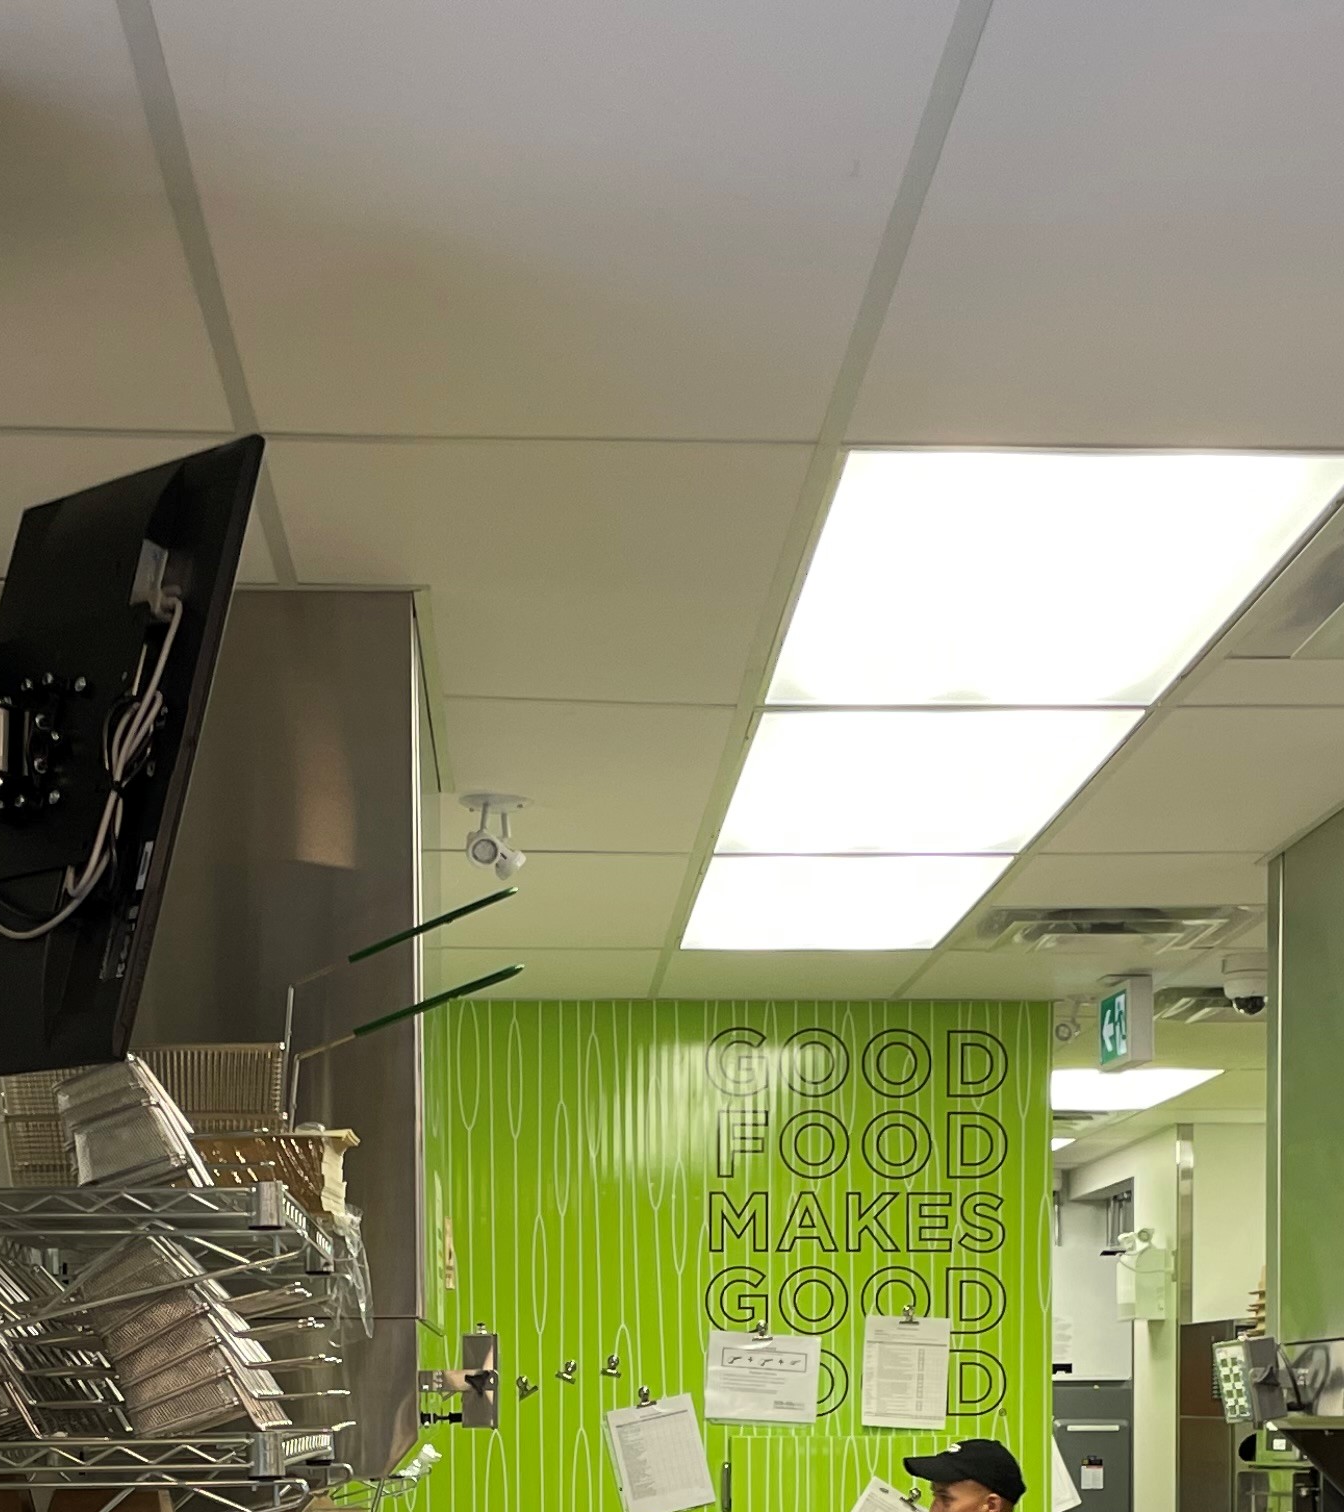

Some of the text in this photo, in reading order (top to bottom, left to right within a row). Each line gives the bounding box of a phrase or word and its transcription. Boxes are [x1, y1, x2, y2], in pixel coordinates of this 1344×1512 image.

[705, 1027, 1008, 1098] GOOD
[716, 1109, 1008, 1179] FOOD
[707, 1190, 1005, 1254] MAKES
[705, 1265, 1007, 1336] GOOD
